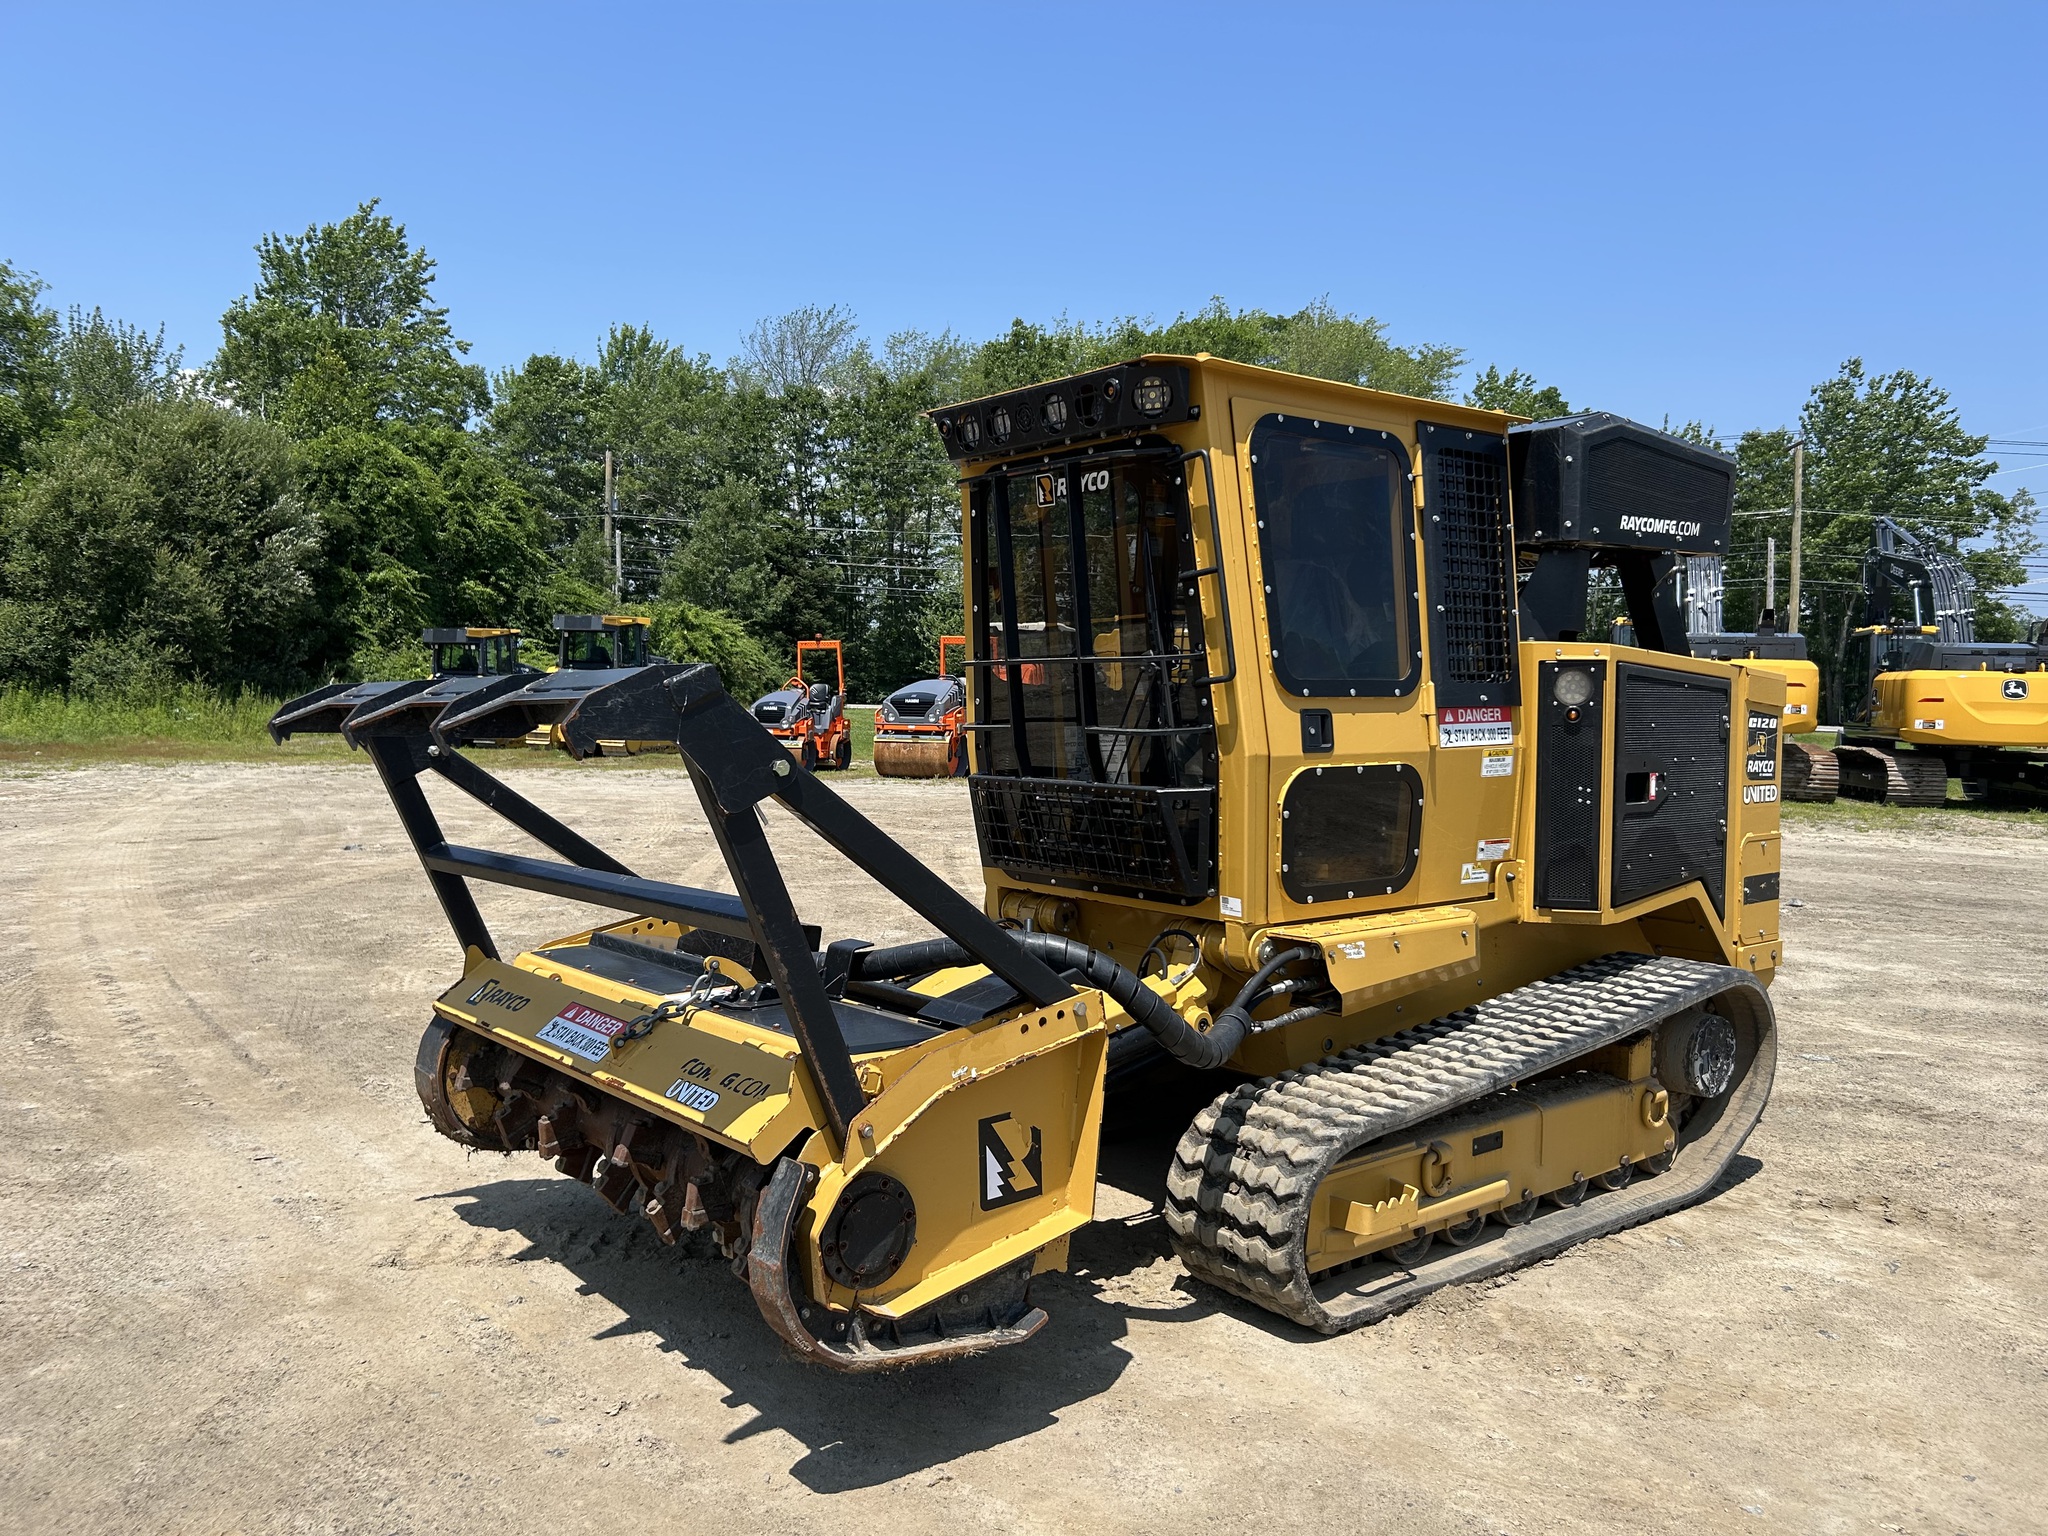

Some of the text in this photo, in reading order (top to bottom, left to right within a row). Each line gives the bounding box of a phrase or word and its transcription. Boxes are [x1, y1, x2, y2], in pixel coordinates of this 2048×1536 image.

[1057, 470, 1109, 497] RYCO
[1620, 515, 1701, 536] RAYCOMFG.COM
[1458, 708, 1501, 722] DANGER
[1748, 717, 1777, 729] C120
[1454, 727, 1511, 742] STAY BACK 300 FEET
[1747, 760, 1774, 773] RAYCO
[1743, 785, 1777, 804] UNITED
[485, 988, 531, 1012] RAYCO
[575, 1010, 623, 1036] DANGER
[551, 1025, 609, 1057] STAY BACK 300 FEET
[665, 1078, 720, 1112] UNITED
